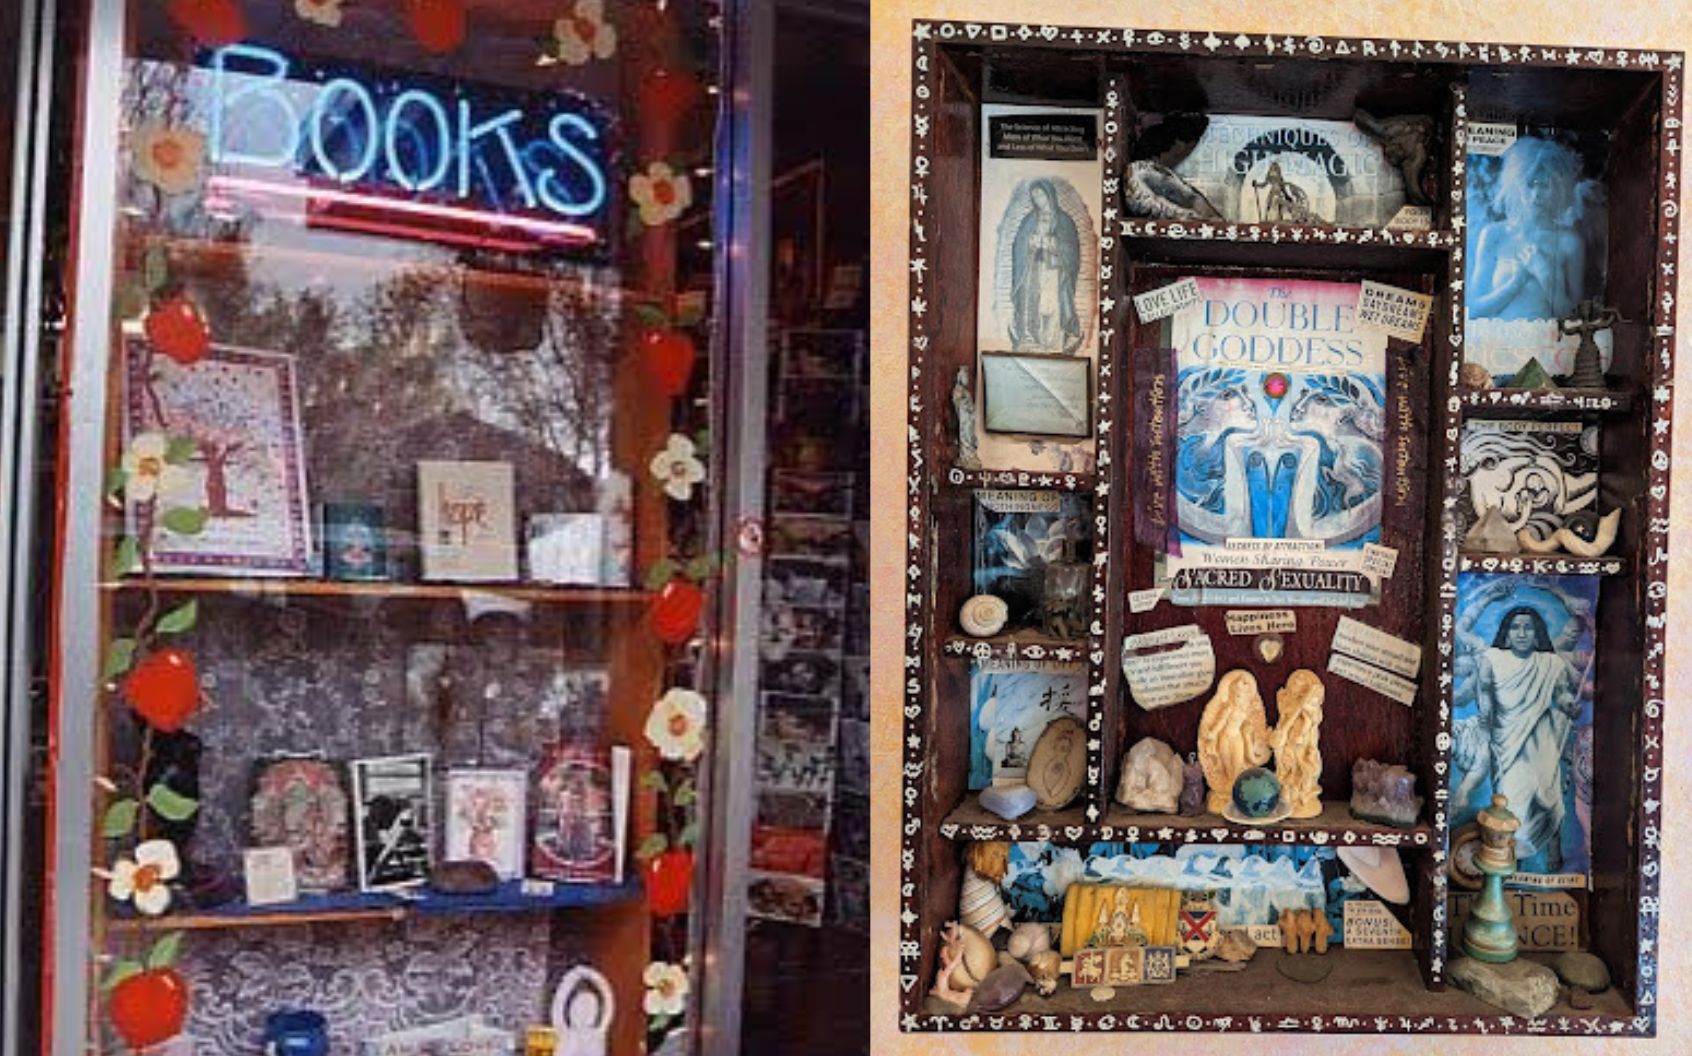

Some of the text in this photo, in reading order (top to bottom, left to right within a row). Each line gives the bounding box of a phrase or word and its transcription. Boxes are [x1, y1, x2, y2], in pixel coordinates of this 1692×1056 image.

[210, 44, 605, 217] BOOKS
[1468, 126, 1515, 137] EANING
[1135, 289, 1170, 314] LOVE
[1169, 281, 1198, 303] LIFE
[1267, 286, 1292, 299] The
[1205, 300, 1355, 333] DOUBLE
[1193, 333, 1364, 367] GODDESS
[1202, 552, 1349, 569] Women Sharing Power
[1173, 568, 1364, 592] SACRED SEXUALITY
[1225, 611, 1289, 622] Happiness
[1230, 621, 1295, 633] Lives Here
[1512, 893, 1577, 917] Time
[1253, 928, 1279, 941] act
